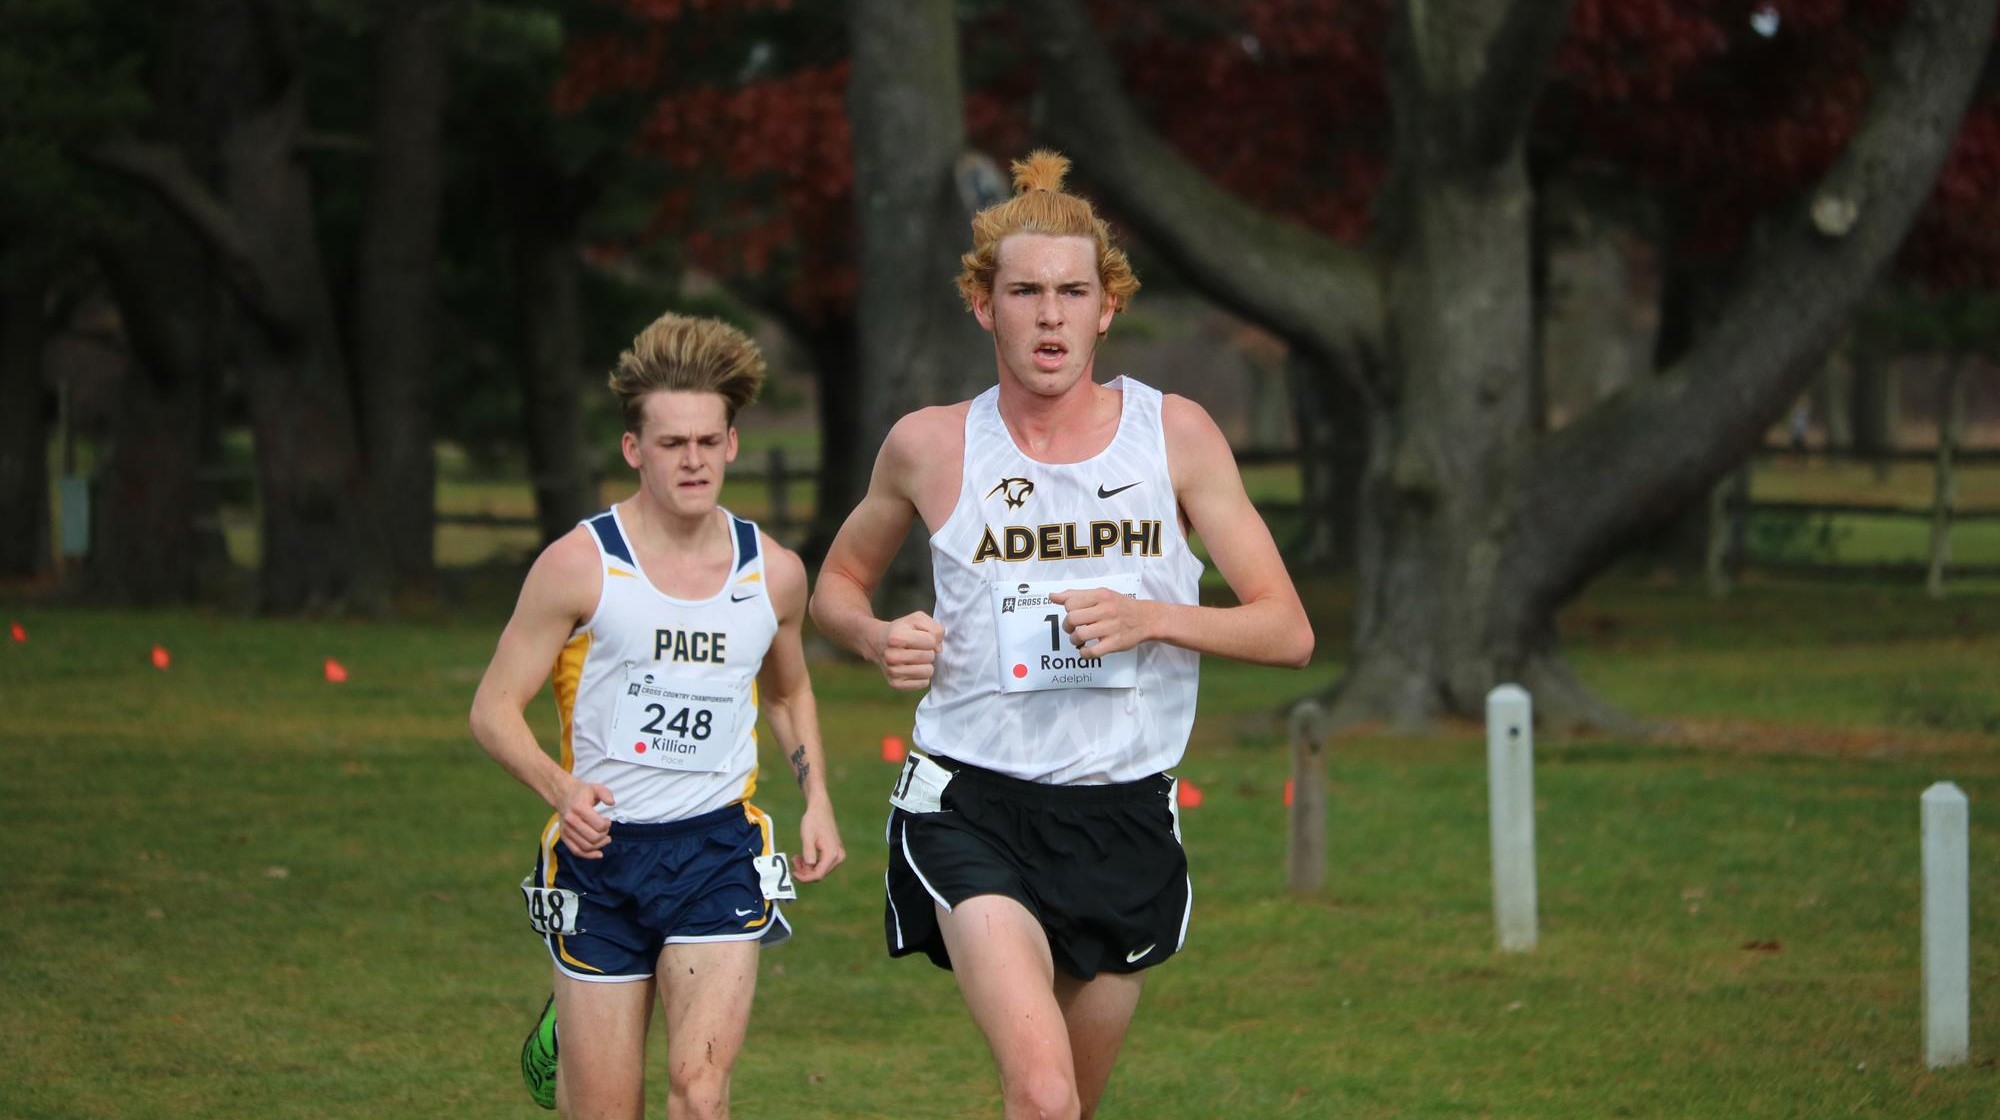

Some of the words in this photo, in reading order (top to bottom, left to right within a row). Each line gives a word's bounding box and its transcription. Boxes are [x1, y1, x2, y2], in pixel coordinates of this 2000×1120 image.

[972, 520, 1163, 564] ADELPHI
[1018, 597, 1041, 606] CROSS
[654, 629, 727, 664] PACE
[1040, 655, 1102, 670] Ronan
[1052, 673, 1092, 684] Adelphi
[641, 687, 661, 696] CROSS
[662, 691, 690, 700] COUNTRY
[690, 694, 734, 704] CHAMPIONSHIPS
[640, 703, 713, 740] 248
[652, 737, 697, 754] Killian
